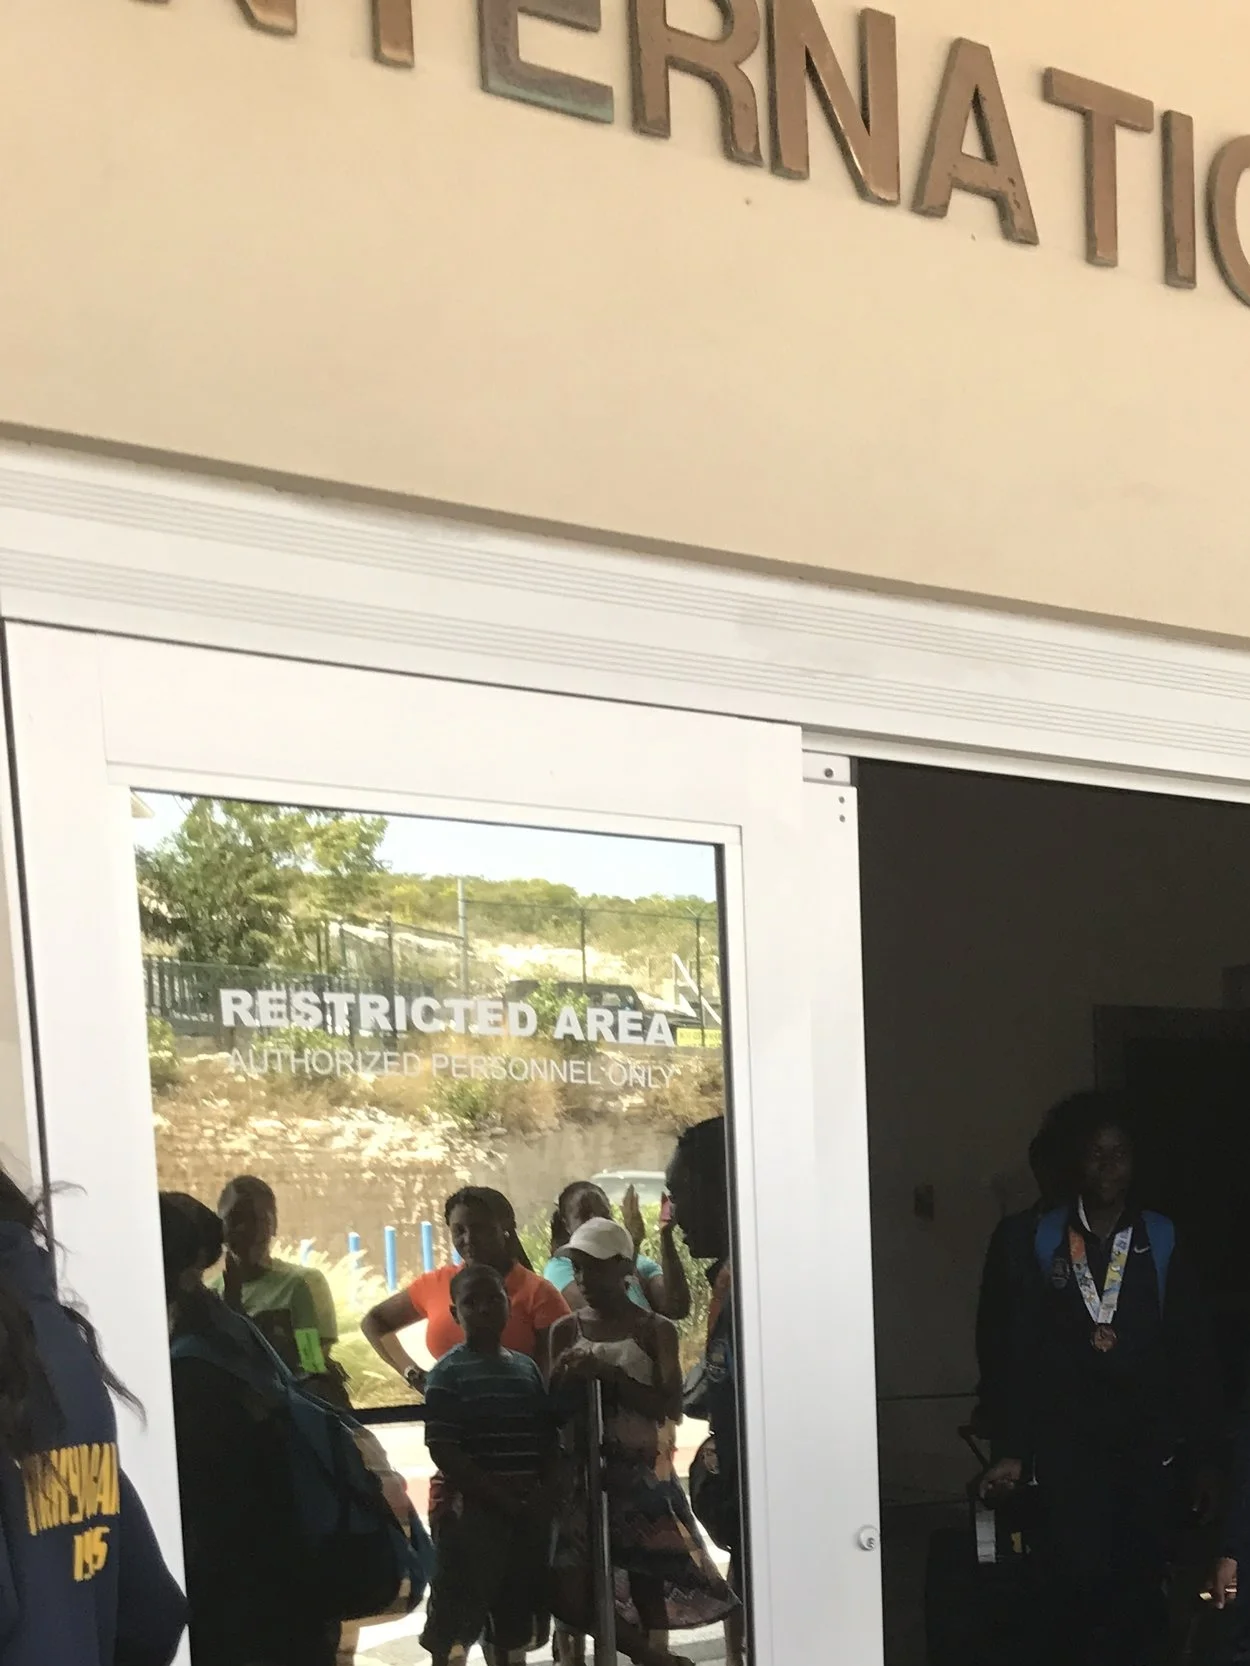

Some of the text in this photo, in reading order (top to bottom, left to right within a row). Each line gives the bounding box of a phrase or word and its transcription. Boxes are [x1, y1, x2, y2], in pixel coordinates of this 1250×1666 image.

[219, 988, 676, 1048] RESTRICTED AREA
[228, 1047, 676, 1090] AUTHORIZED PERSONNEL ONLY
